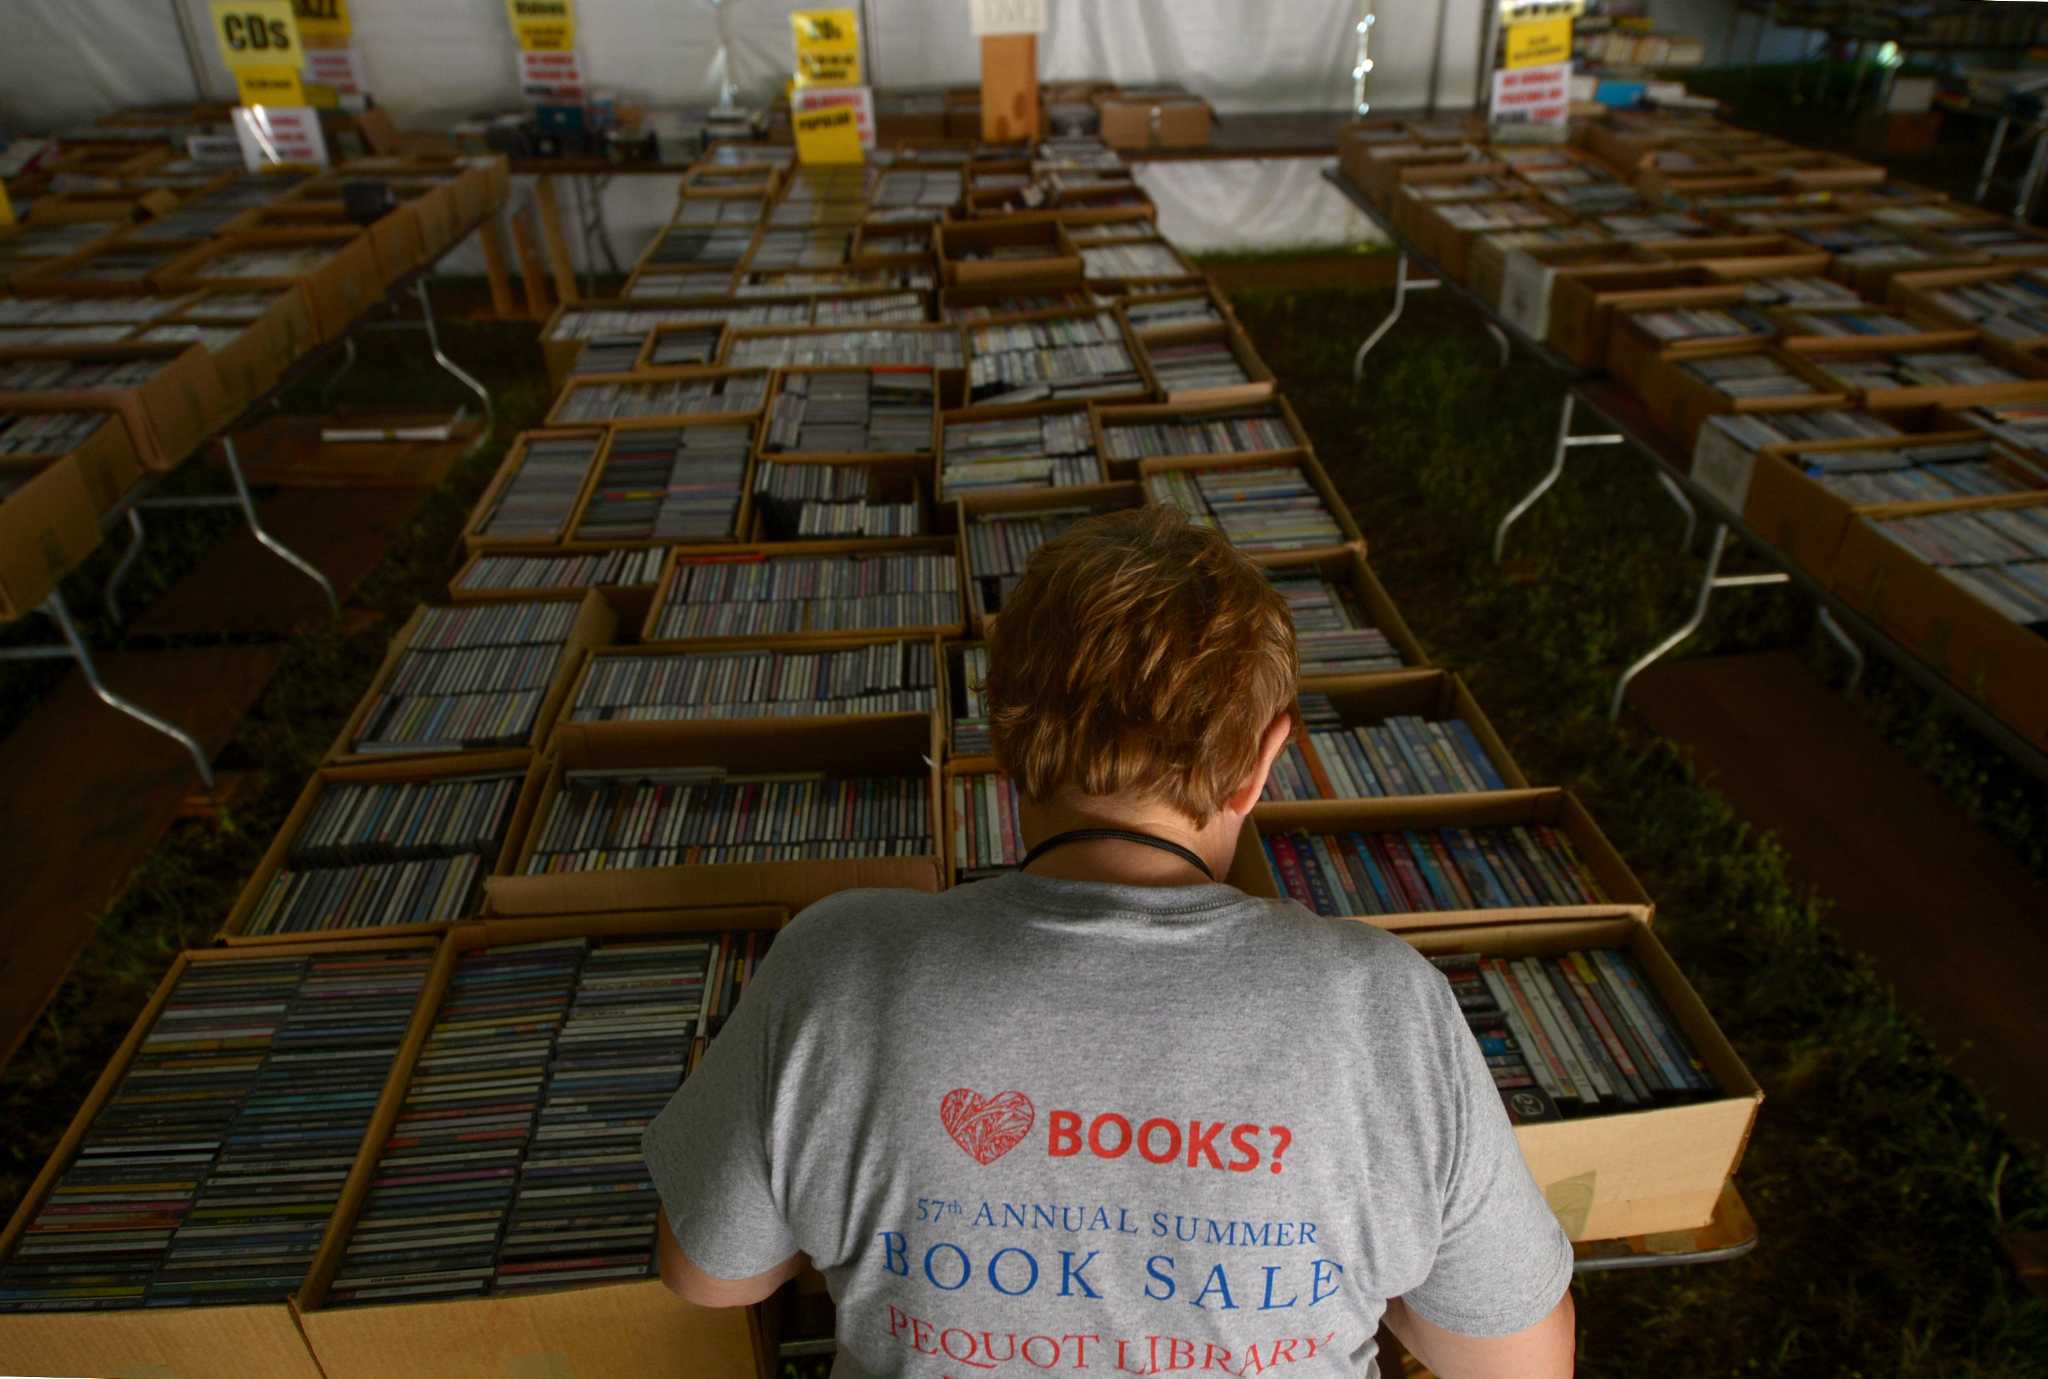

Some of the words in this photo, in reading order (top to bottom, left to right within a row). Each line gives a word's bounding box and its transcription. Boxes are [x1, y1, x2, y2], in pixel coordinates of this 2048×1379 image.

[223, 13, 290, 49] CDs
[1047, 1109, 1293, 1176] BOOKS?
[916, 1199, 963, 1223] 57th
[972, 1200, 1140, 1234] ANNUAL
[1151, 1212, 1318, 1249] SUMMER
[878, 1231, 1105, 1300] BOOK
[1142, 1254, 1346, 1313] SALE
[887, 1304, 1101, 1371] PEQUOT
[1114, 1331, 1336, 1377] LIBRARY
